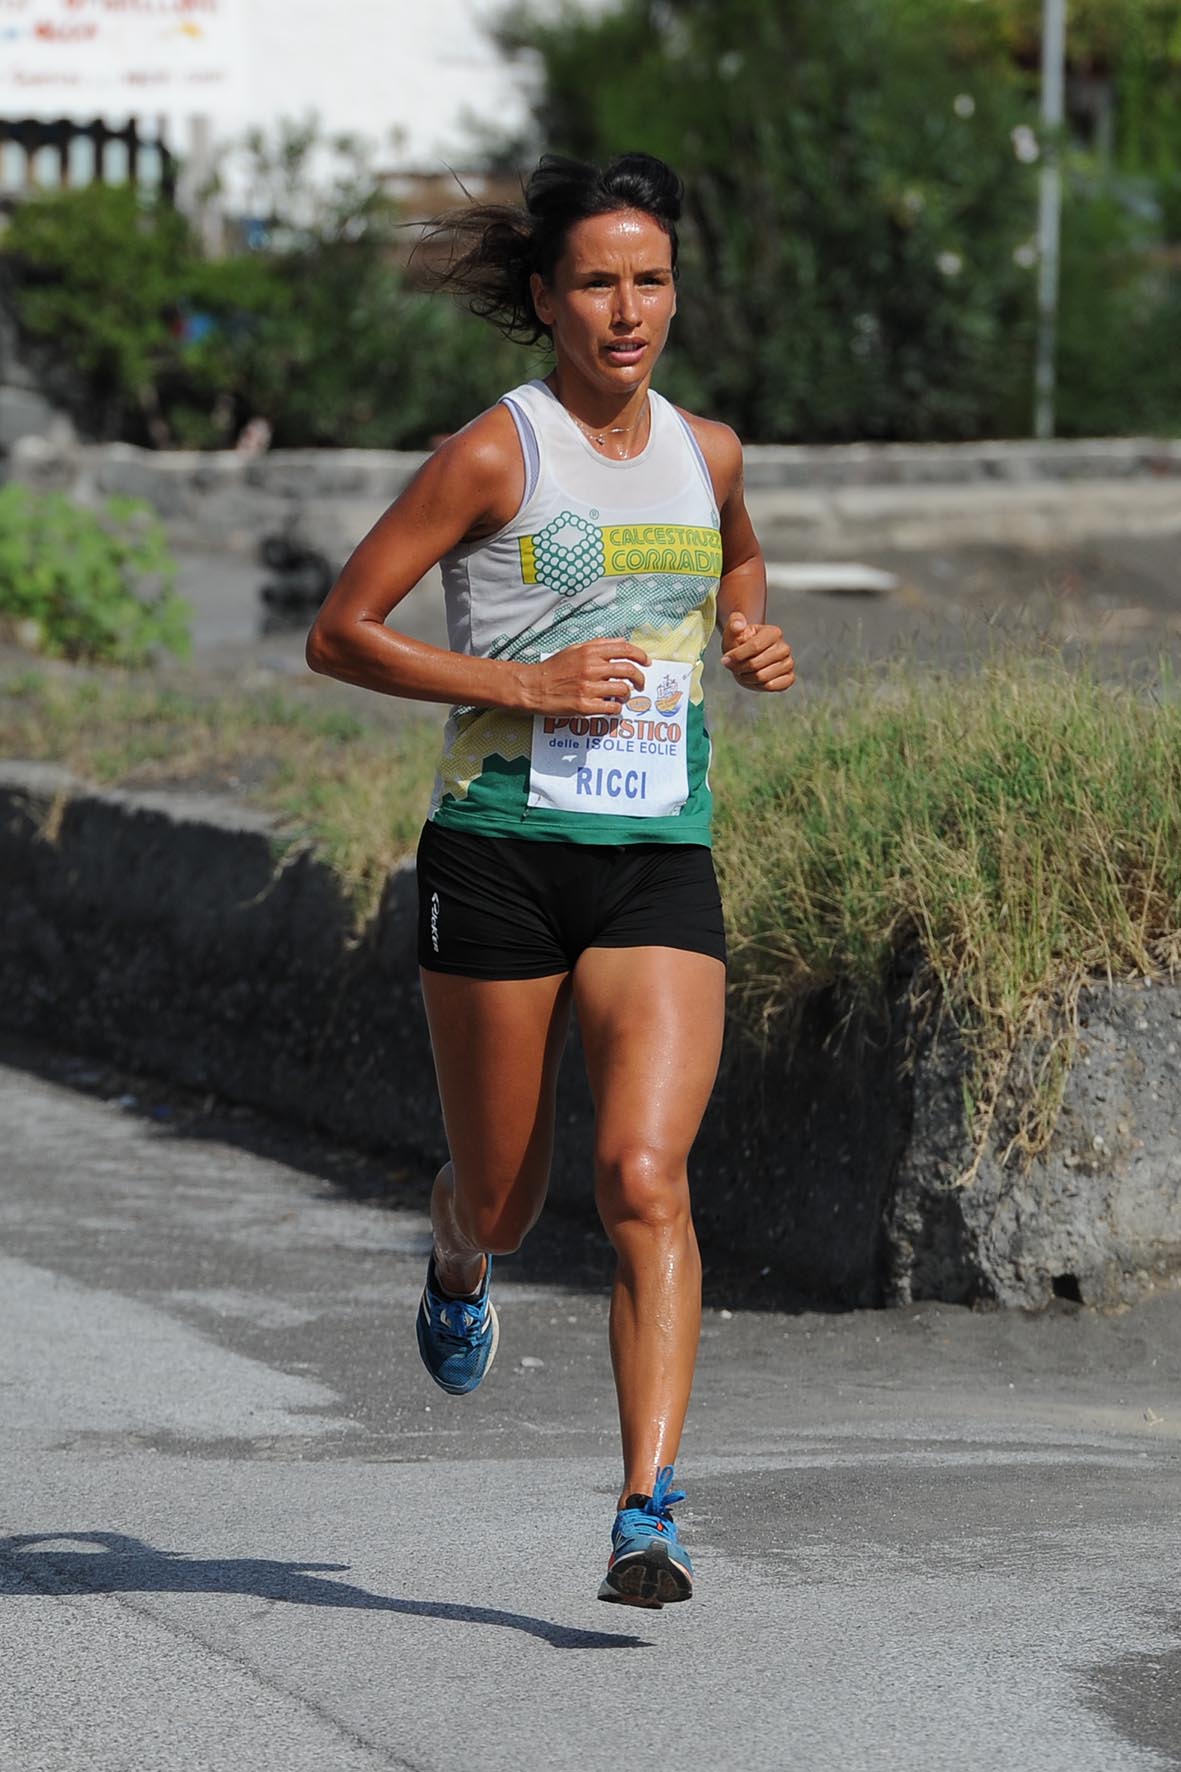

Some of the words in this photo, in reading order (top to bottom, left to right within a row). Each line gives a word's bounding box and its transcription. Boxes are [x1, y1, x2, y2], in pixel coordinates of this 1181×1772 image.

[543, 715, 682, 743] PODISTICO
[549, 737, 580, 749] delle
[586, 737, 635, 752] ISOLE
[640, 741, 677, 756] EOLIE
[576, 767, 647, 799] RICCI
